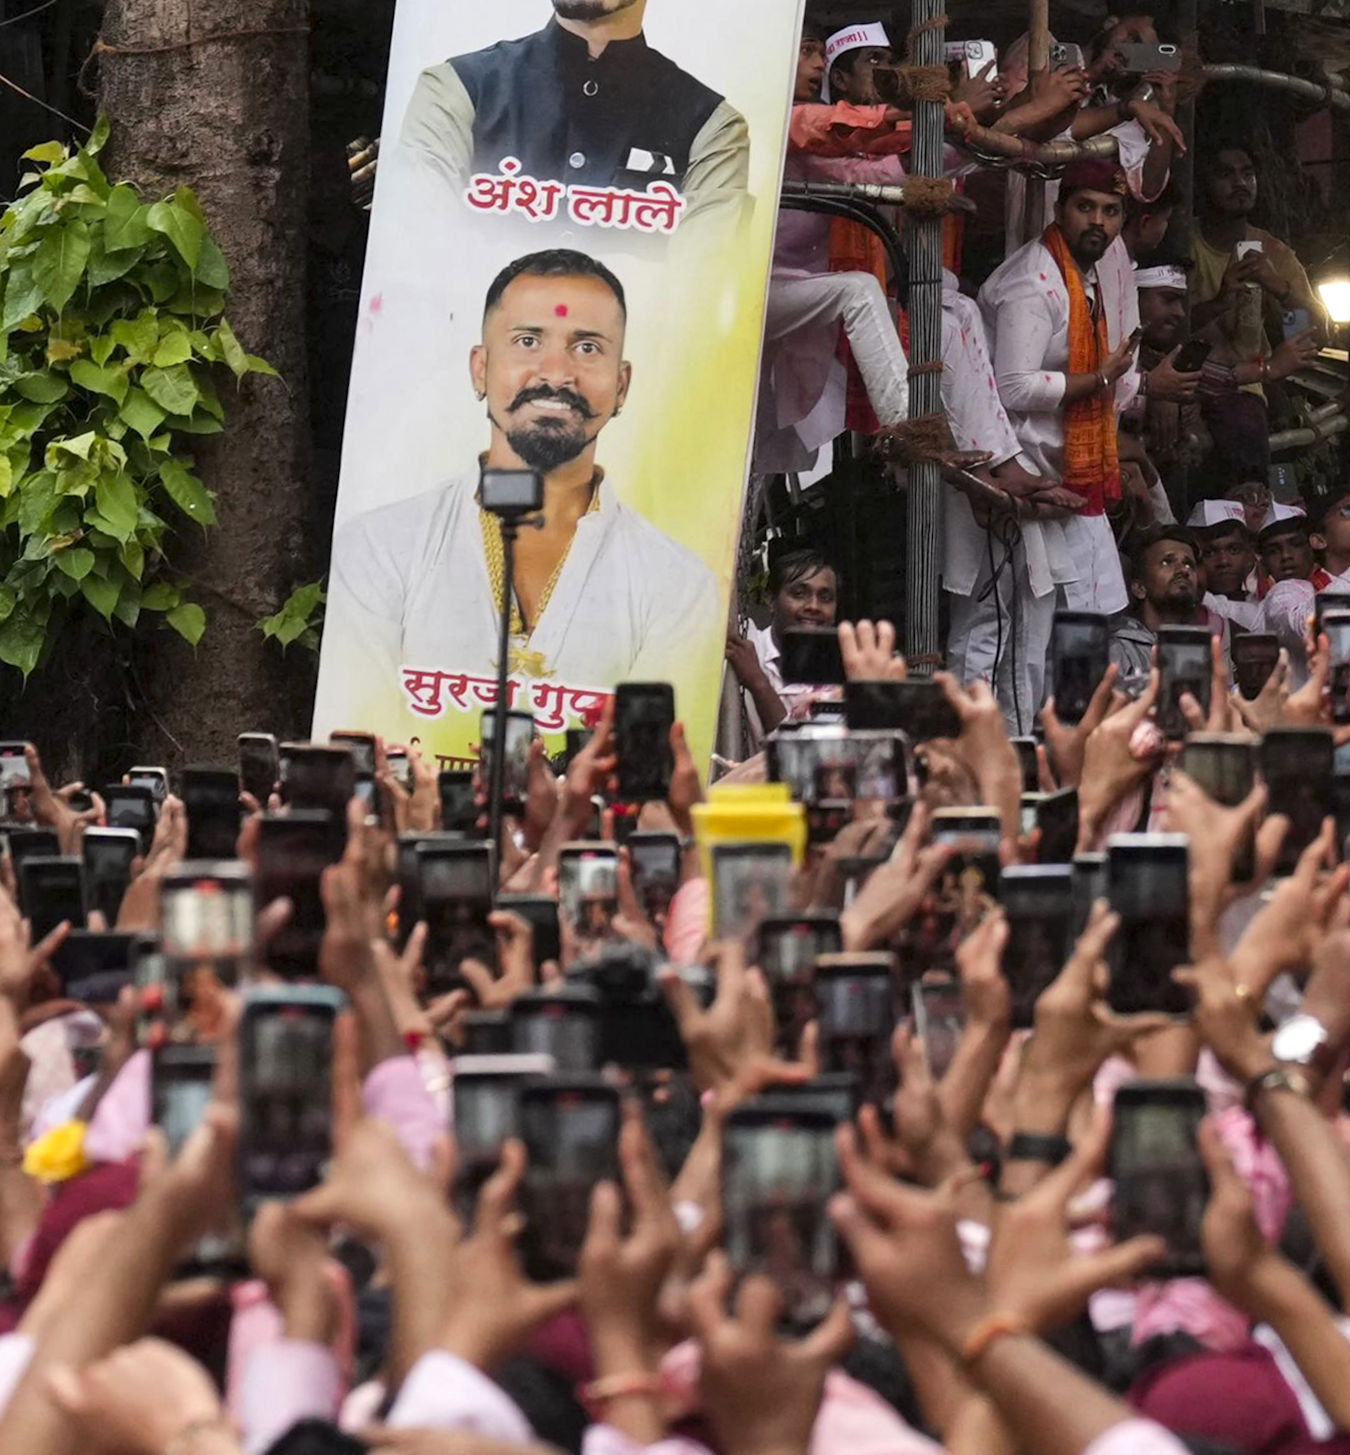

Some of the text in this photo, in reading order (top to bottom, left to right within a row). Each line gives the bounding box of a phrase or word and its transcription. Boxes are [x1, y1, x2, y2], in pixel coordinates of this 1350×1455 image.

[467, 160, 683, 230] अंश लाले
[402, 668, 520, 715] सुरज
